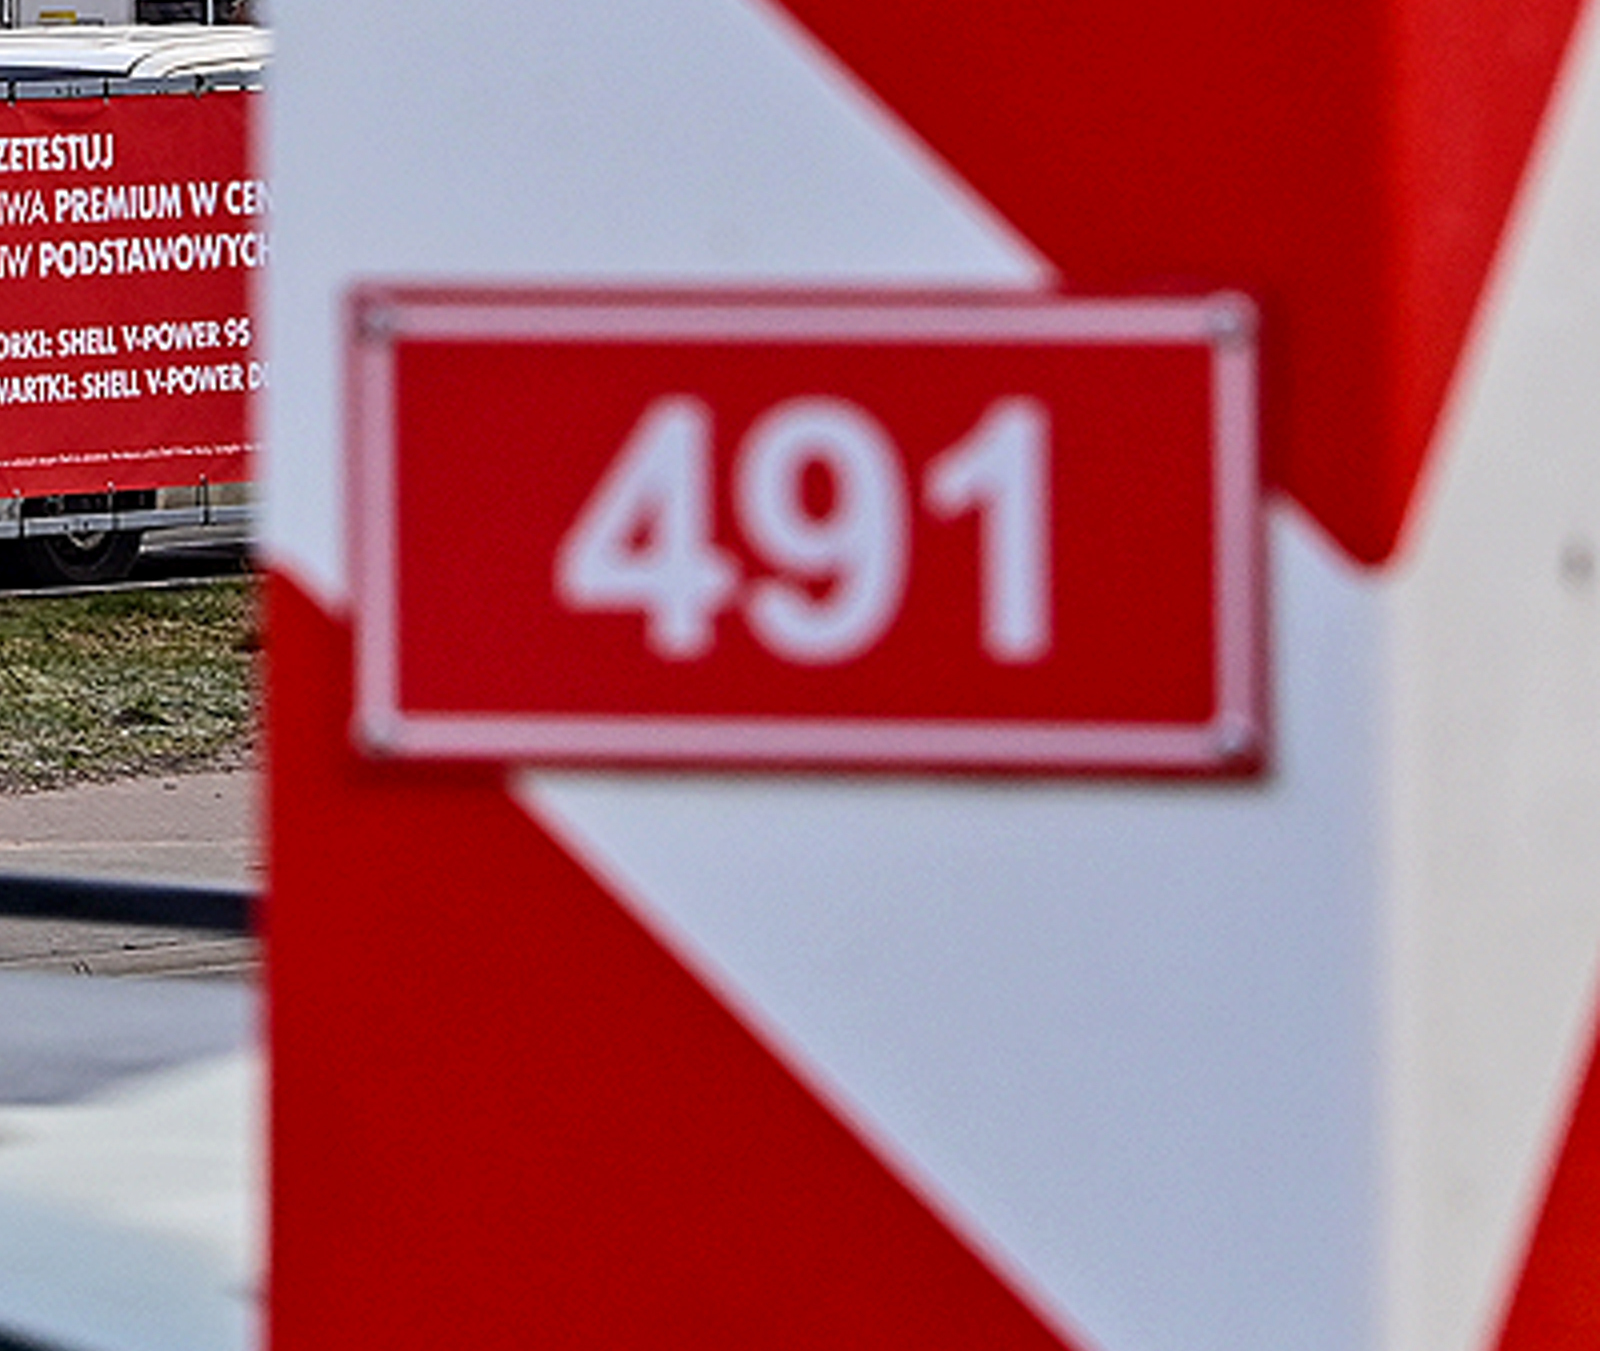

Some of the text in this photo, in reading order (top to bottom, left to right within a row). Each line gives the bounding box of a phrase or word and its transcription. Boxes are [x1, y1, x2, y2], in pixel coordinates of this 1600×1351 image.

[55, 184, 181, 223] PREMIUM
[187, 182, 220, 215] W
[57, 326, 117, 356] SHELL
[122, 321, 221, 352] V-POWER
[223, 318, 251, 347] 95
[81, 370, 141, 401] SHELL
[145, 364, 244, 395] V-POWER
[552, 393, 1052, 664] 491
